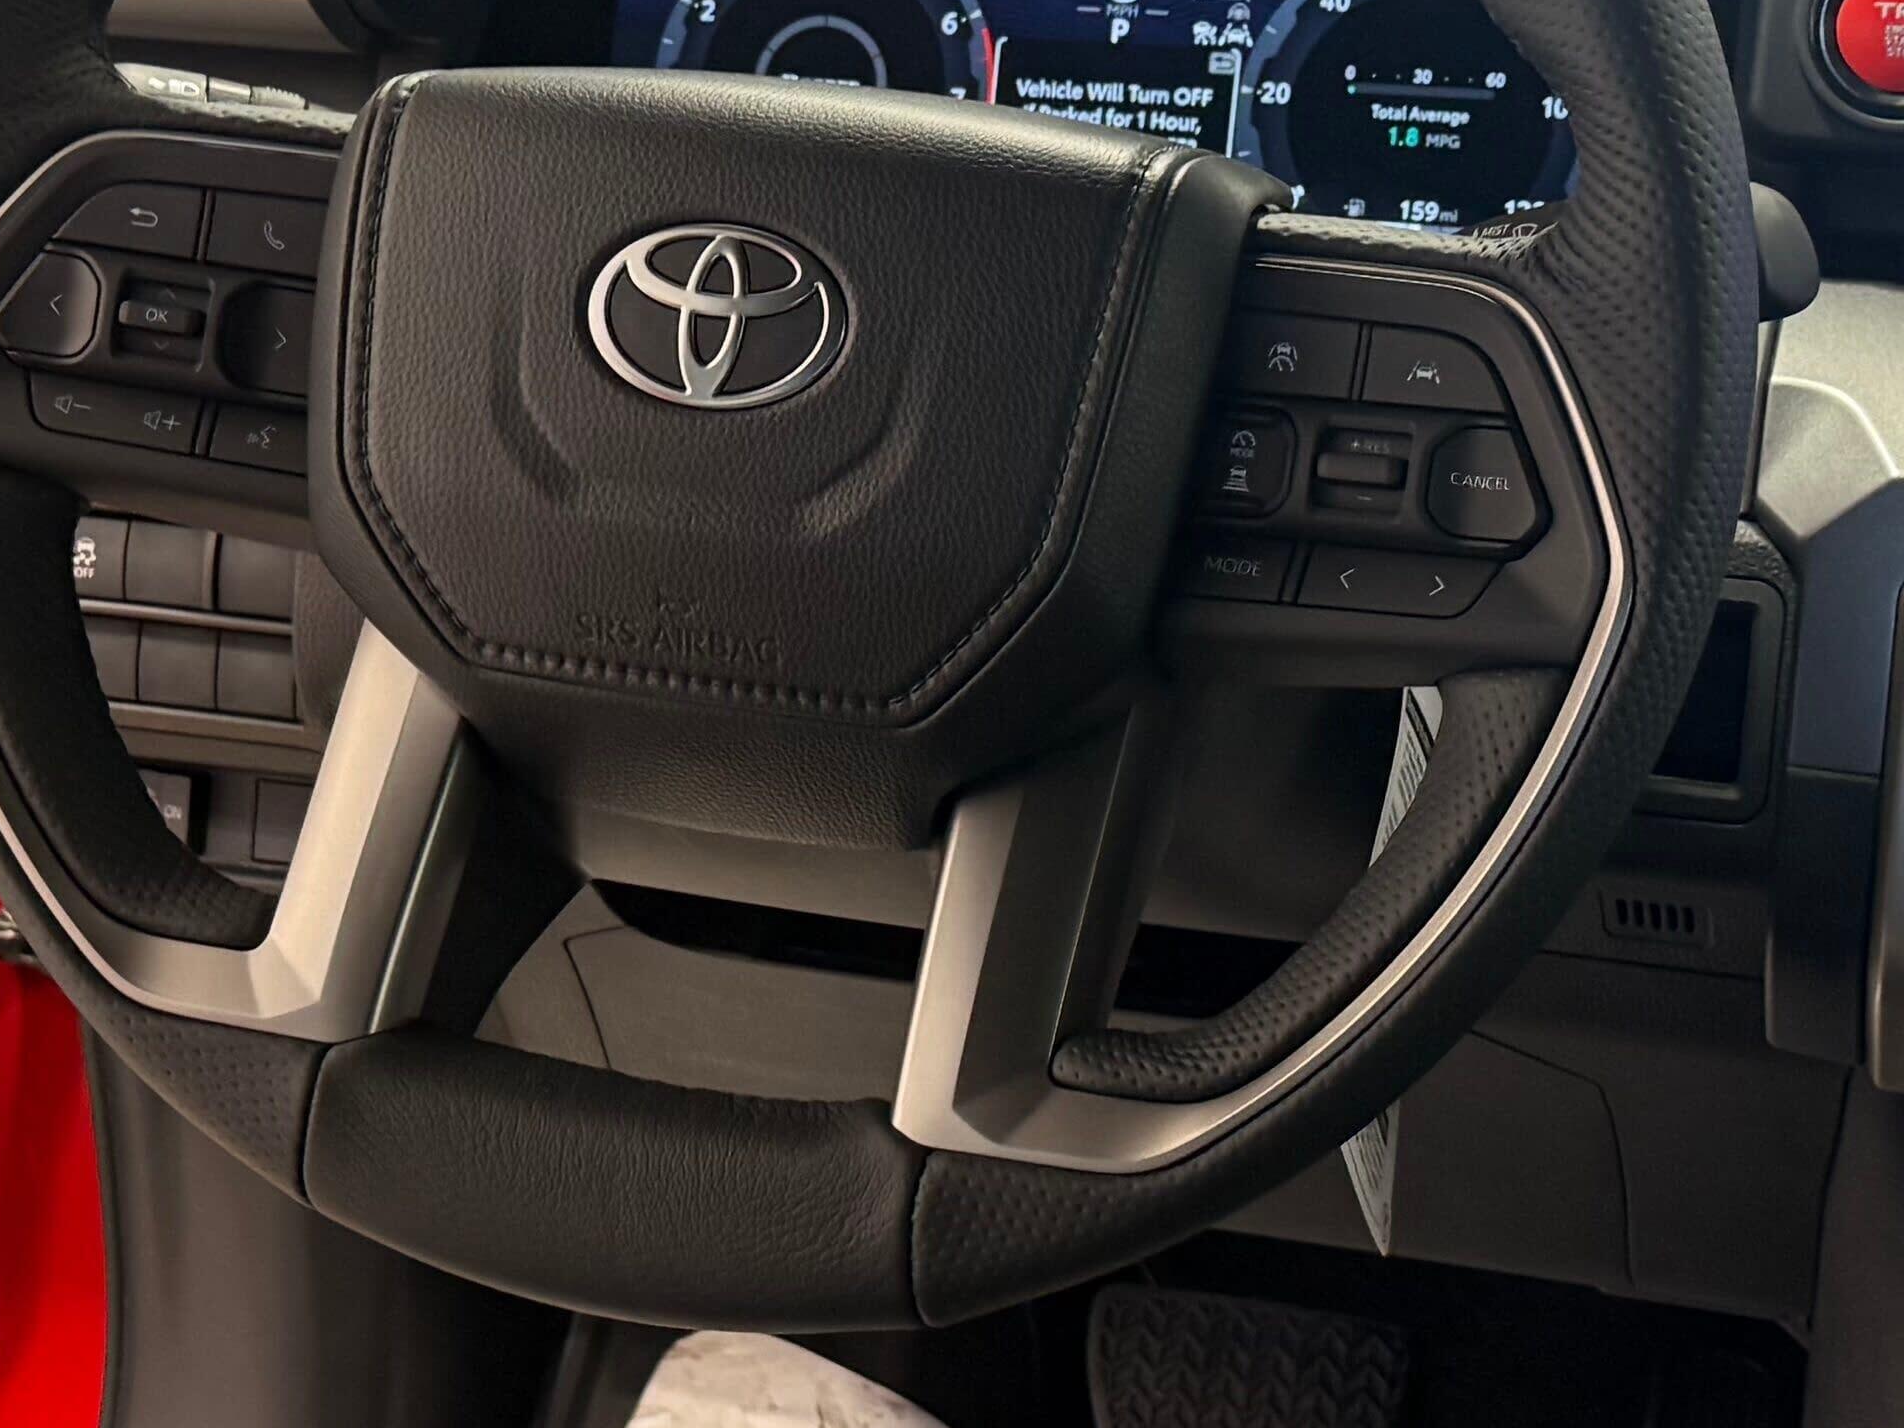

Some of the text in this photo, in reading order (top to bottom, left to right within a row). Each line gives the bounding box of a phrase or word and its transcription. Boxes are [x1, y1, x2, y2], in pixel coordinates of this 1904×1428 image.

[1105, 4, 1139, 18] MPH
[940, 11, 958, 36] 6
[1110, 18, 1131, 45] P
[1345, 64, 1357, 81] 0
[1015, 78, 1084, 101] Vehicle
[1086, 81, 1125, 103] Will
[1172, 86, 1215, 108] OFF
[1259, 81, 1292, 105] 20
[1105, 107, 1134, 128] for
[1137, 110, 1146, 129] 1
[1149, 111, 1202, 135] Hour,
[1370, 103, 1471, 129] Total Average
[1387, 126, 1461, 149] 1.8 MPG
[144, 307, 169, 323] OK
[1450, 471, 1510, 491] CANCEL
[1204, 556, 1263, 577] MODE
